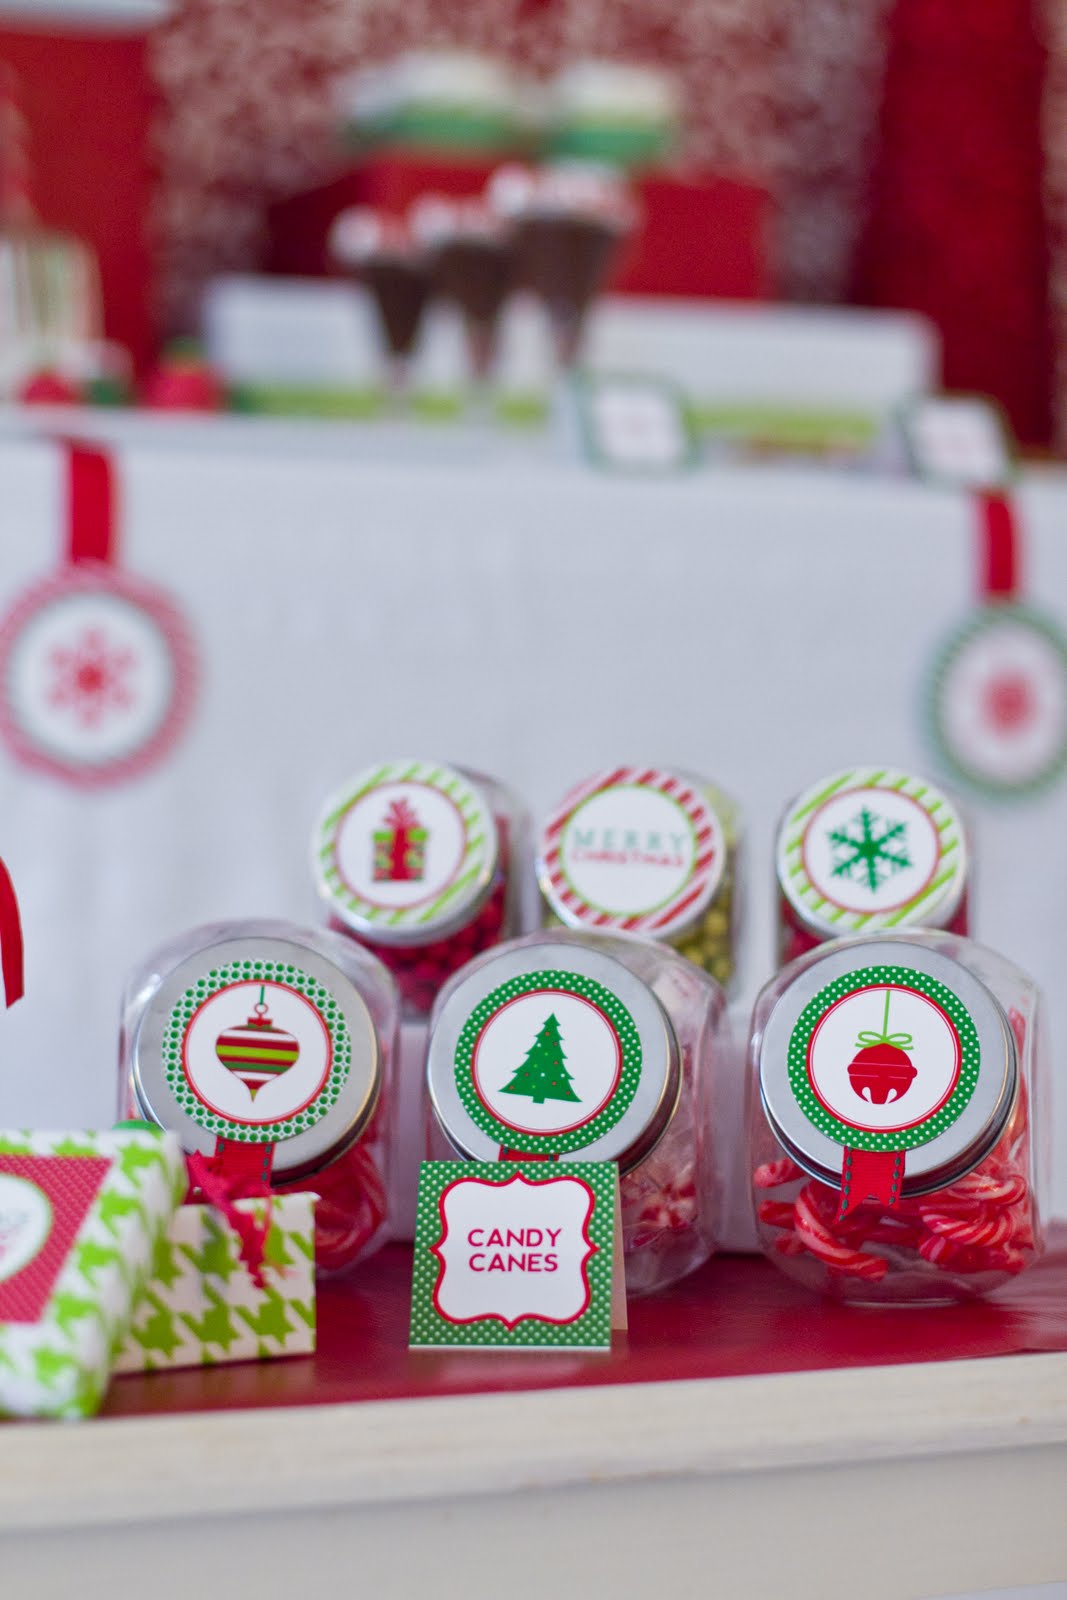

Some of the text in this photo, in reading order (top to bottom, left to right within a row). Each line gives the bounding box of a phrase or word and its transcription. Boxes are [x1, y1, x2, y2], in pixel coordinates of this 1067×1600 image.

[573, 829, 687, 849] MERRY
[467, 1228, 562, 1247] CANDY
[468, 1253, 558, 1272] CANES
